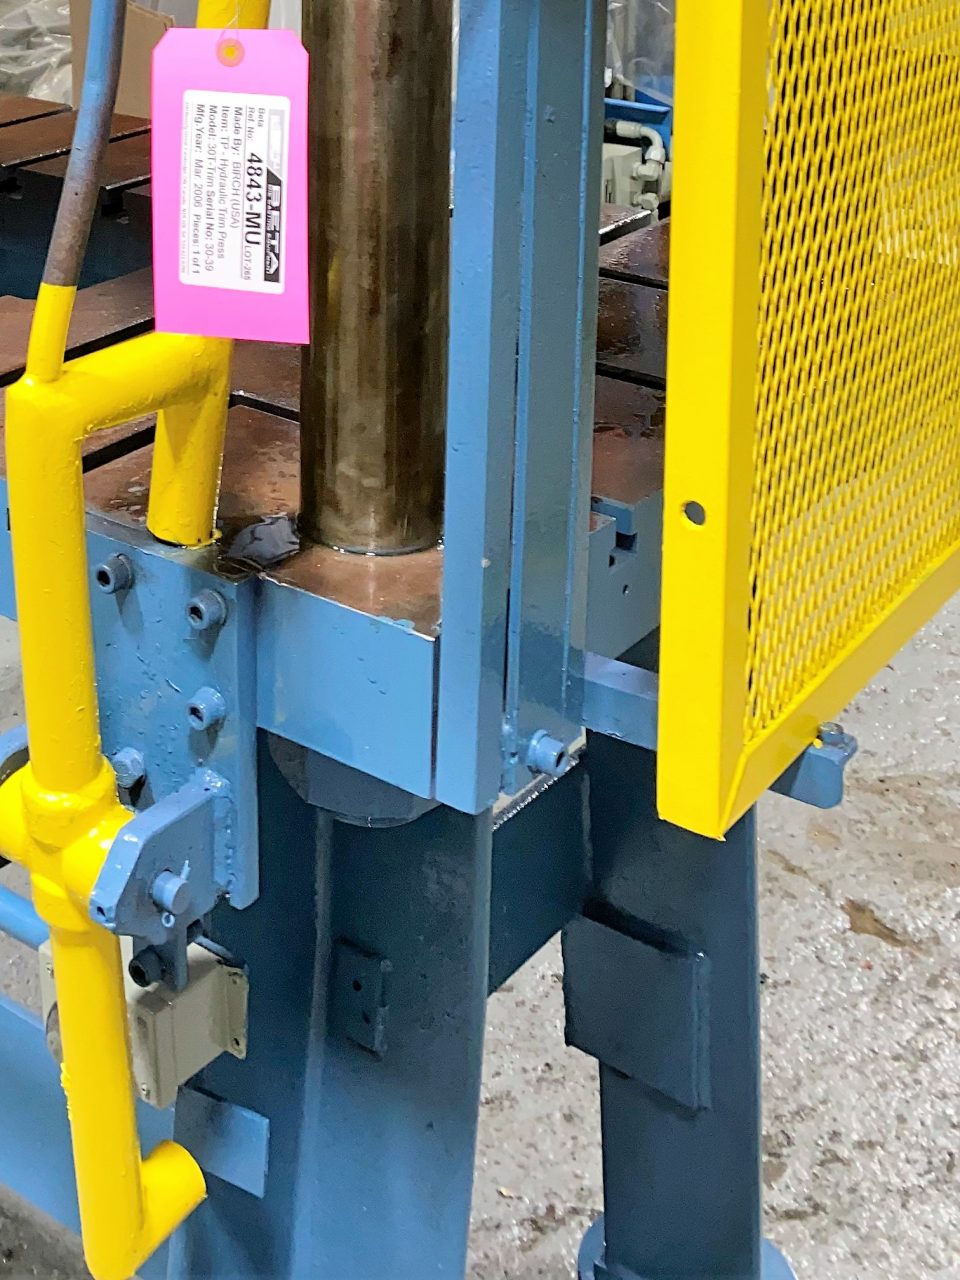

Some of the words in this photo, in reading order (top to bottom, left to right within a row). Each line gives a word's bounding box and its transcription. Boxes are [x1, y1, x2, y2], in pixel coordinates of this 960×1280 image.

[208, 105, 217, 140] Model:
[221, 106, 230, 132] Item:
[234, 107, 243, 135] Made
[257, 108, 265, 127] Beta
[221, 136, 229, 149] TP
[231, 139, 242, 155] By:
[206, 144, 217, 187] 30T-Trim
[232, 162, 241, 196] BIRCH
[194, 184, 203, 207] 2006
[218, 158, 229, 205] Hydraulic
[206, 190, 215, 219] Serial
[245, 153, 263, 245] 4843-MU
[218, 208, 227, 228] Trim
[230, 199, 240, 228] (USA)
[193, 214, 201, 247] Pieces:
[205, 223, 214, 240] No:
[268, 185, 280, 274] BETA
[205, 244, 214, 271] 30-39
[218, 231, 227, 259] Press
[192, 258, 200, 266] of
[244, 245, 252, 280] LOT-265
